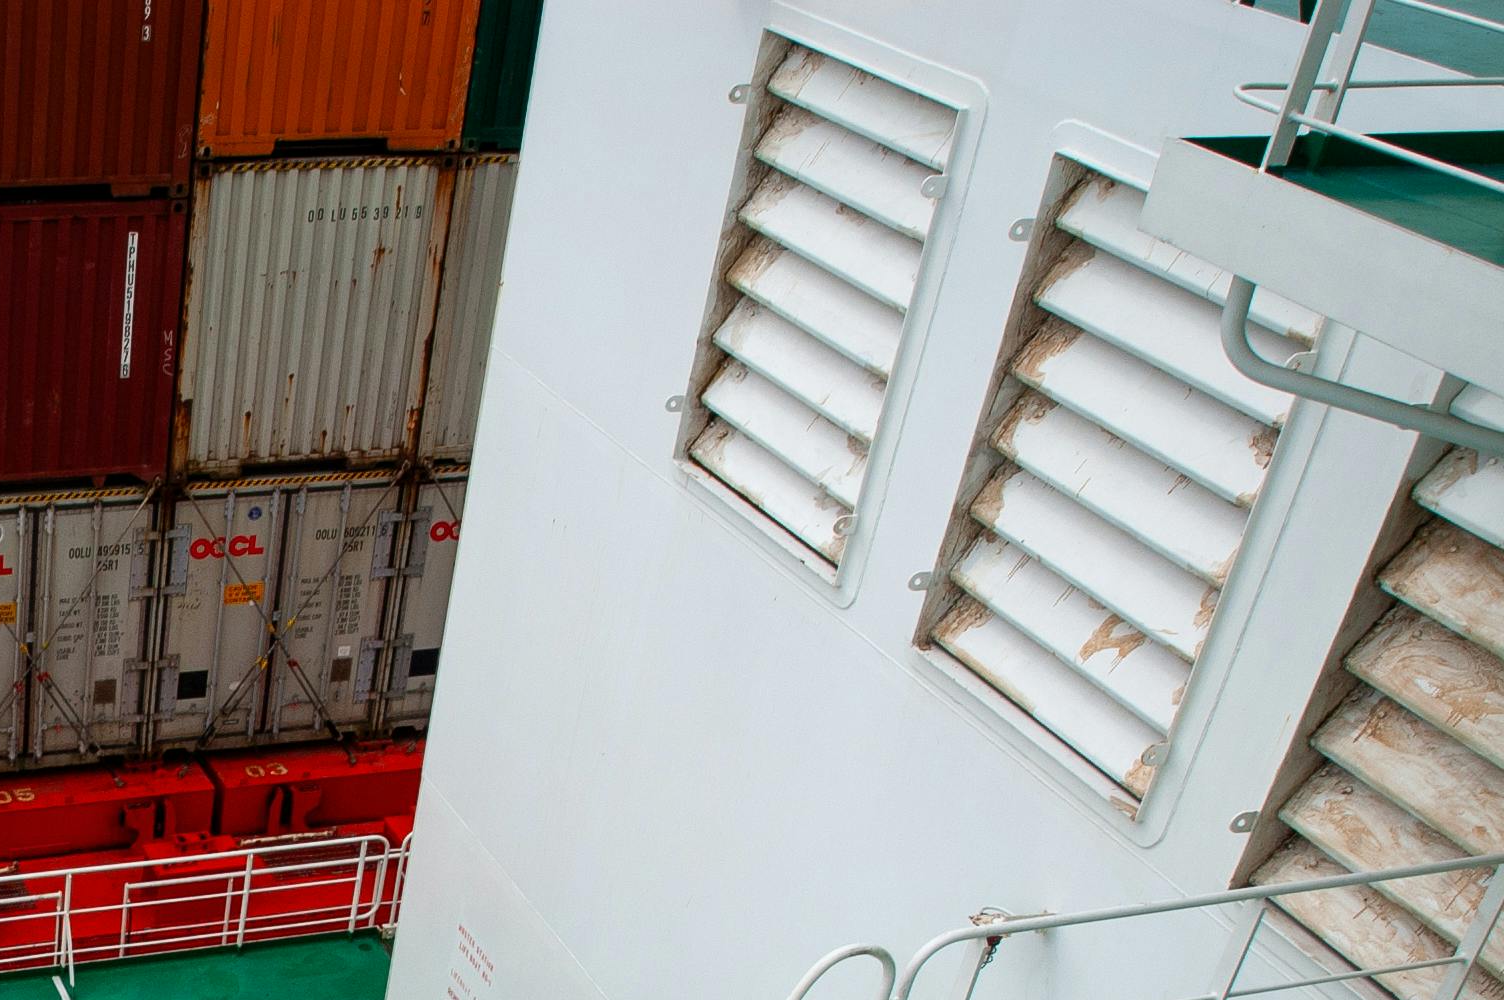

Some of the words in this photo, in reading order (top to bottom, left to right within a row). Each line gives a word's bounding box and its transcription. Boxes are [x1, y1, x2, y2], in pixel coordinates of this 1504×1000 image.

[68, 546, 92, 560] OOLU
[190, 535, 264, 560] OOCL
[244, 762, 288, 778] 03
